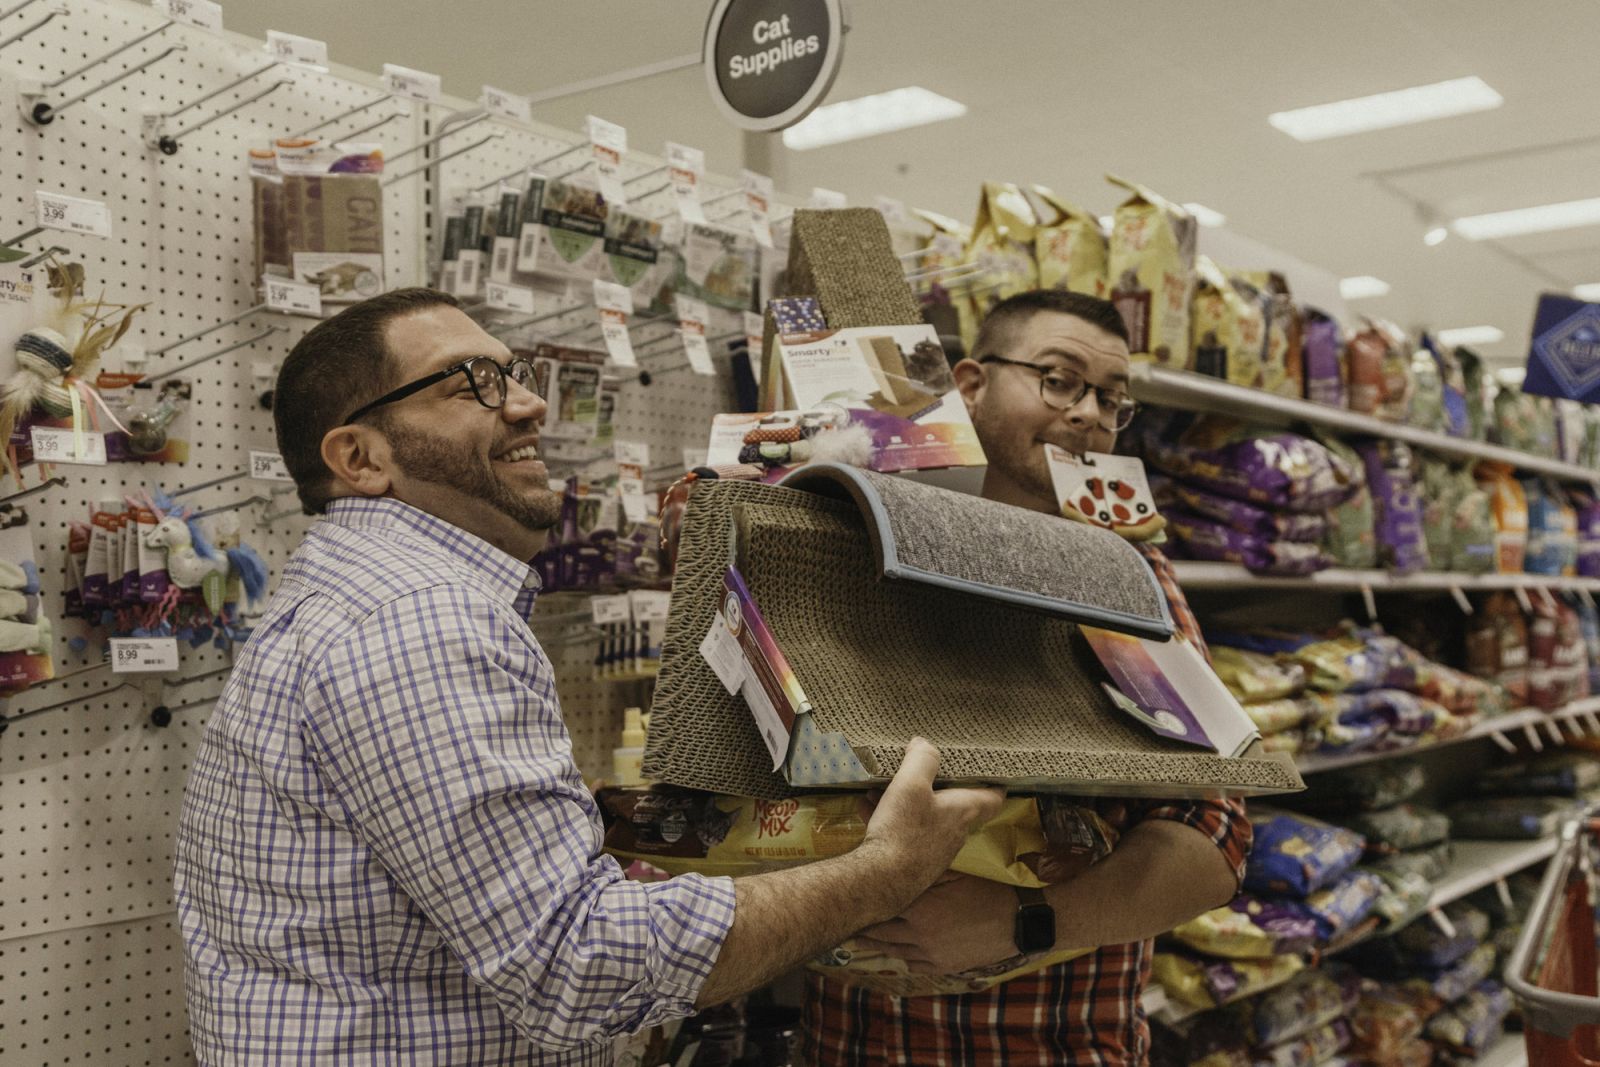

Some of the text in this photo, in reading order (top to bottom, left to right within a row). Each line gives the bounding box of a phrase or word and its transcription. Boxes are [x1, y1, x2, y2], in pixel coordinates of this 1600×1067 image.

[752, 13, 791, 44] Cat
[729, 34, 820, 79] Supplies
[43, 207, 65, 220] 3.99
[0, 279, 33, 294] rtyKat
[37, 440, 58, 451] 3.99
[117, 649, 138, 660] 8.99
[752, 798, 800, 822] Meow
